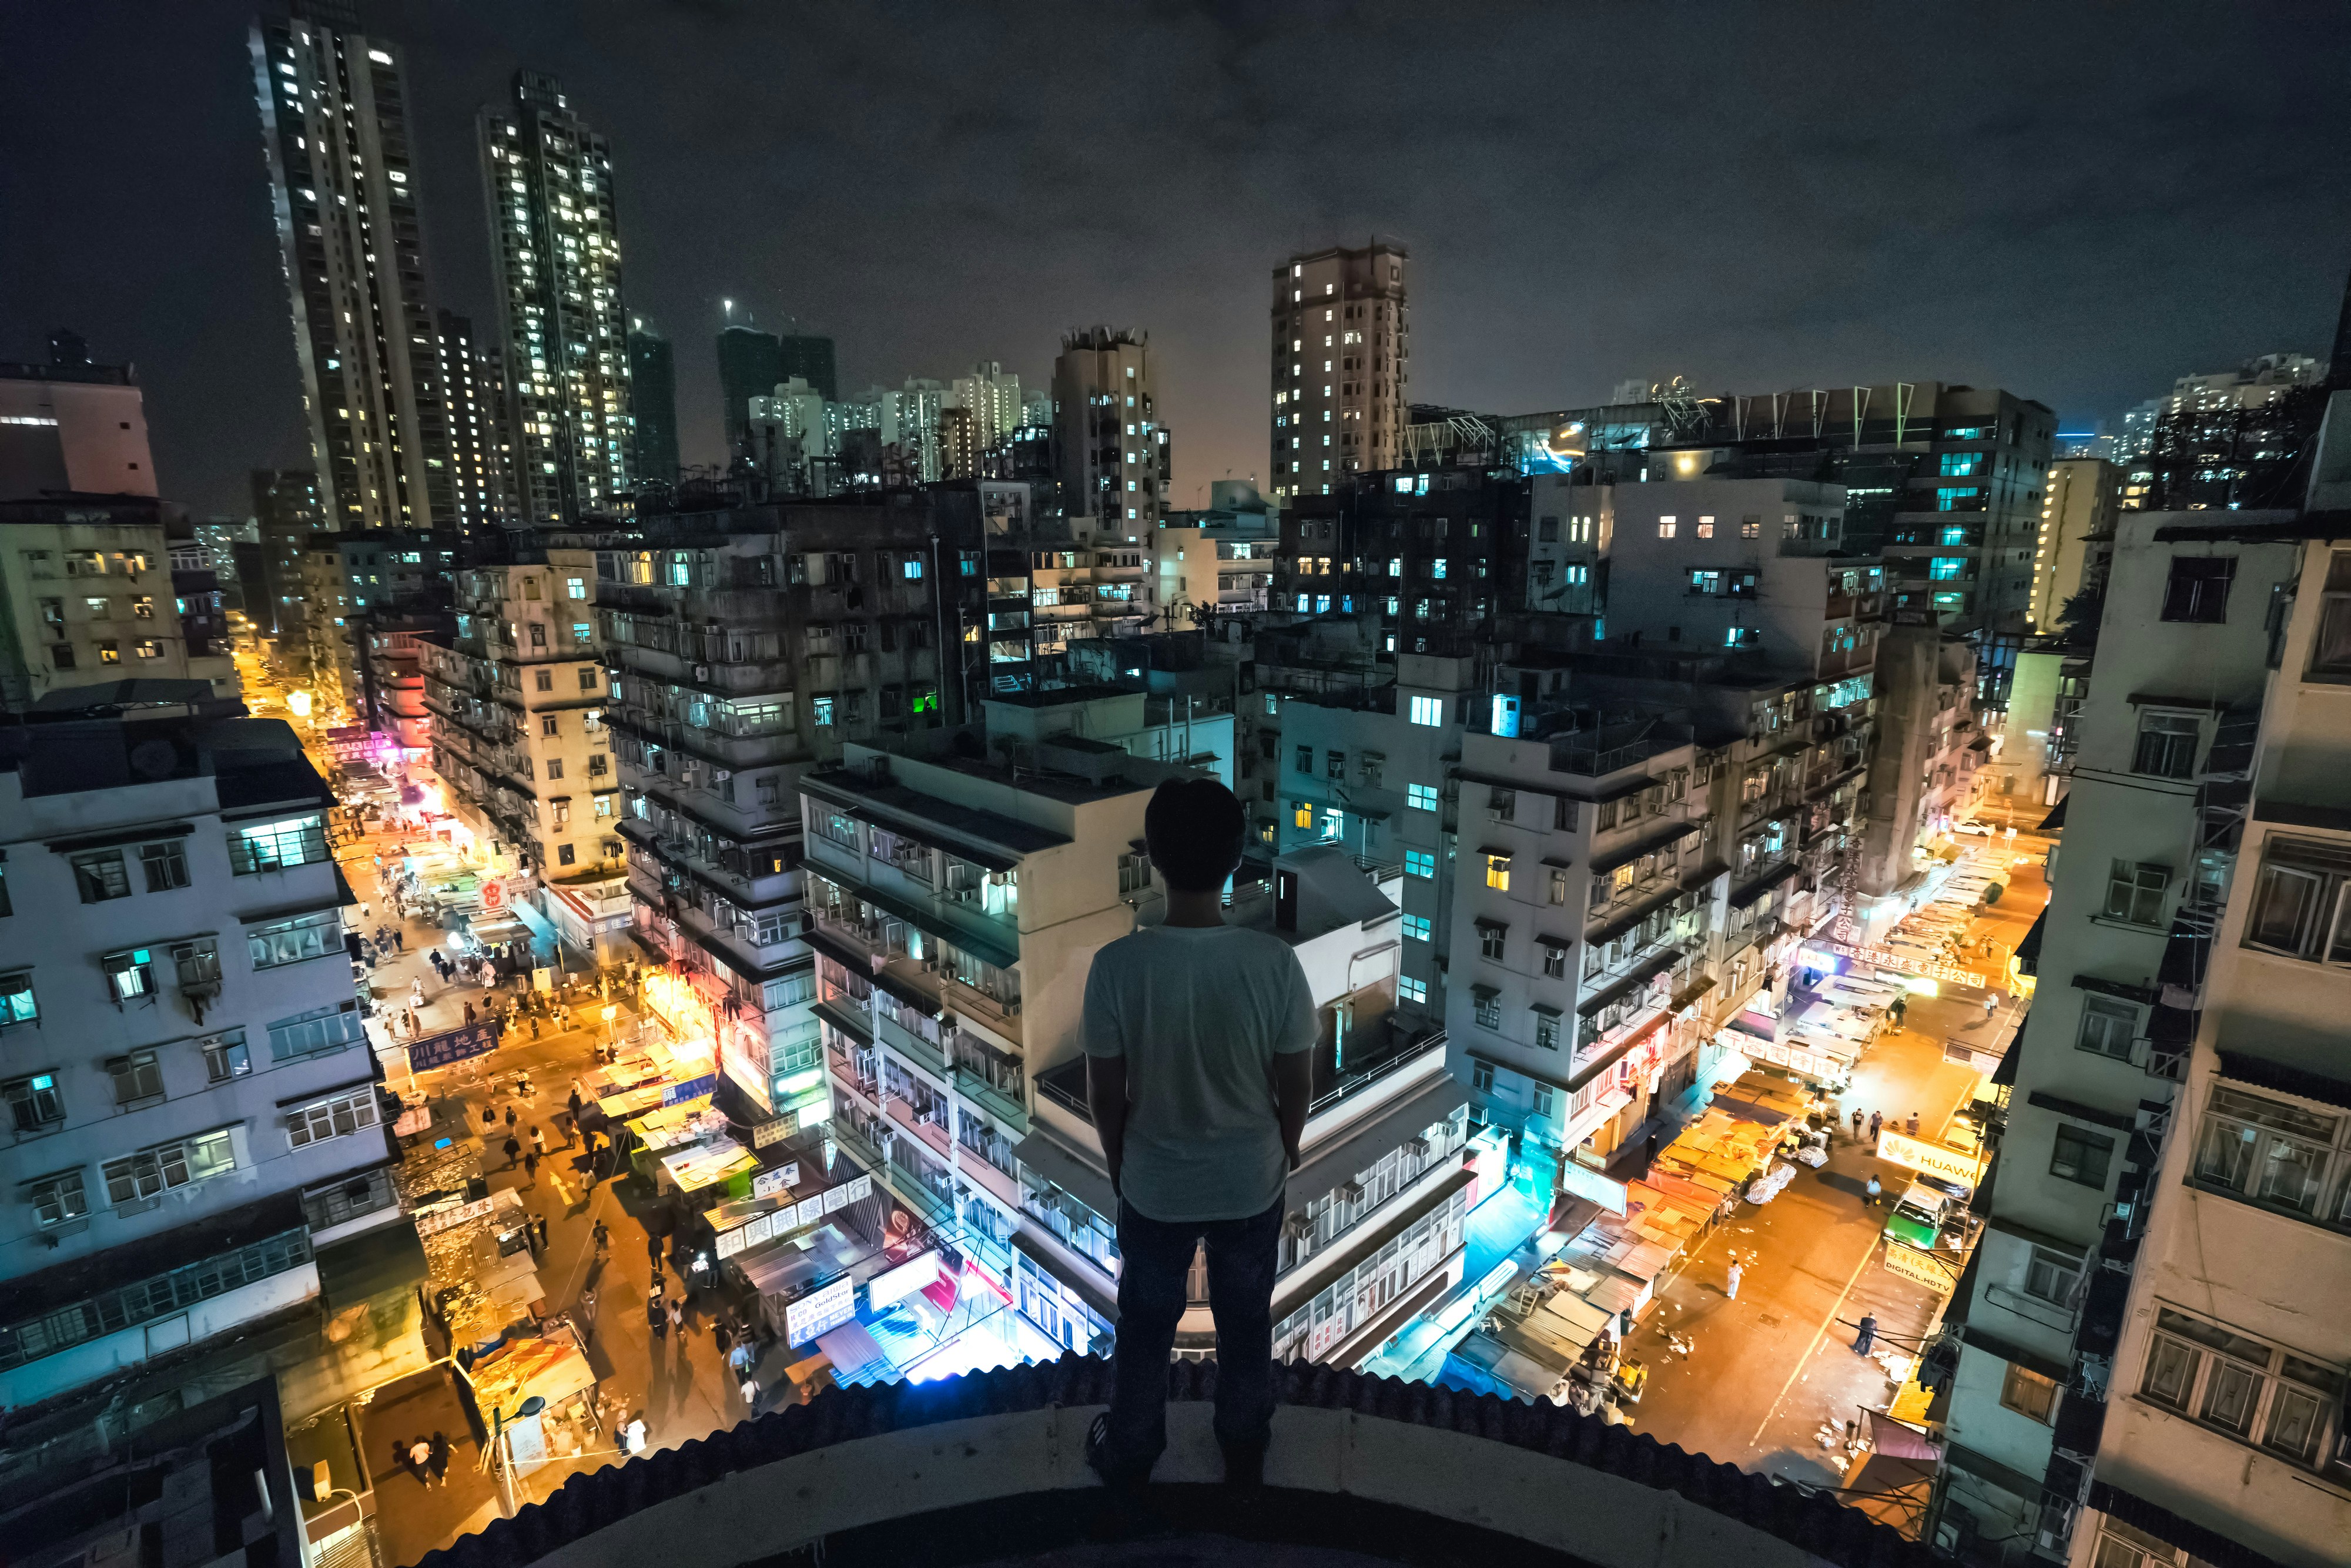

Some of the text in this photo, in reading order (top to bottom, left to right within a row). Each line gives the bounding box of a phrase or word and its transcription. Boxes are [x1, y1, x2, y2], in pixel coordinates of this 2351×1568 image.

[1850, 947, 1984, 987] 香港永盛電子公司
[1921, 1155, 1975, 1181] HUAWE
[719, 1177, 869, 1255] 和興無線電行
[789, 1281, 849, 1314] SONY aiwa
[815, 1288, 849, 1309] GoldStar
